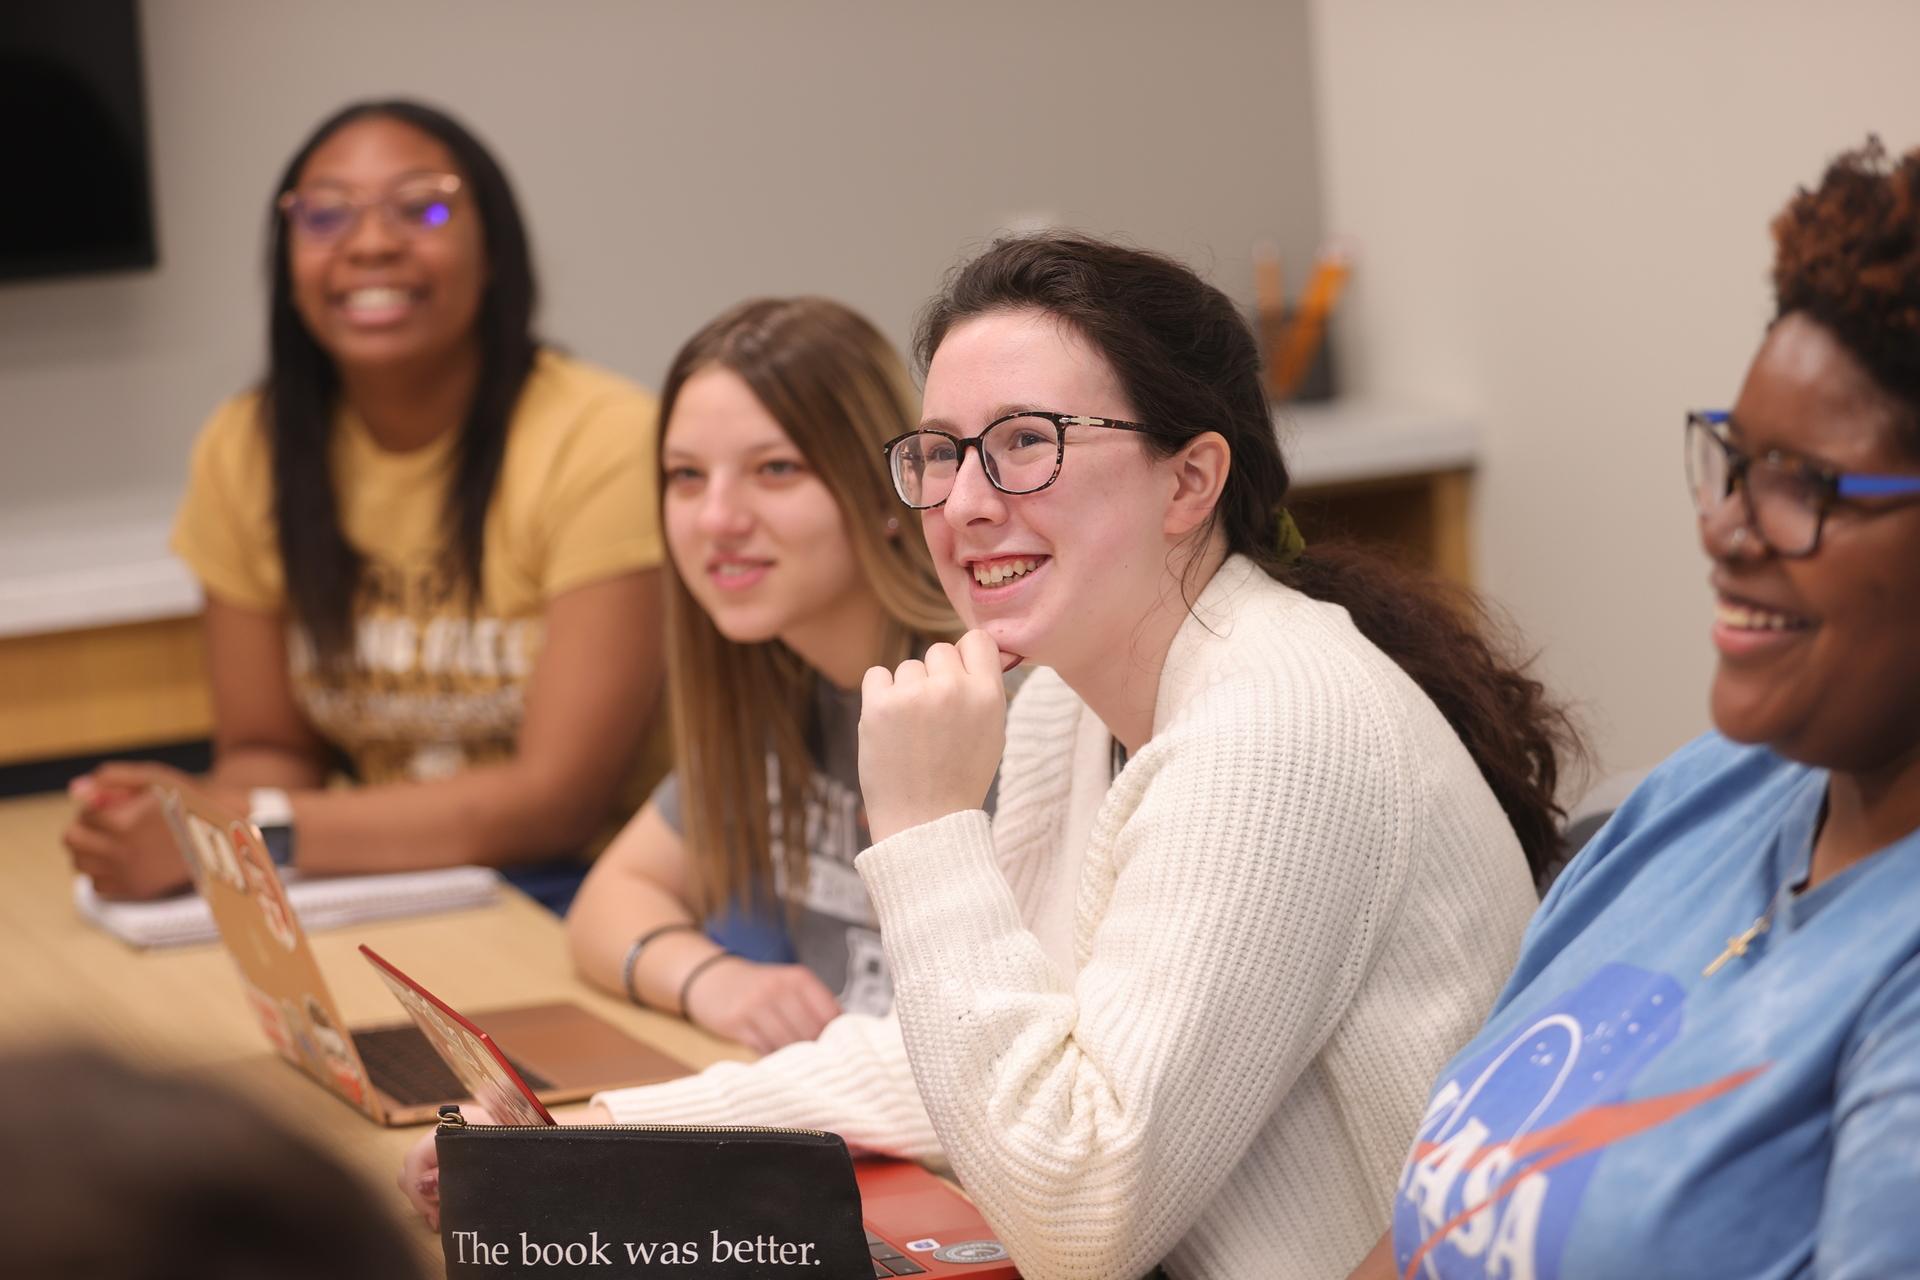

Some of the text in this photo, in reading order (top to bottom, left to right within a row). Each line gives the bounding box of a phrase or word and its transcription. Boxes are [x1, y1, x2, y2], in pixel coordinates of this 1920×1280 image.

[451, 1229, 821, 1265] The book was better.
